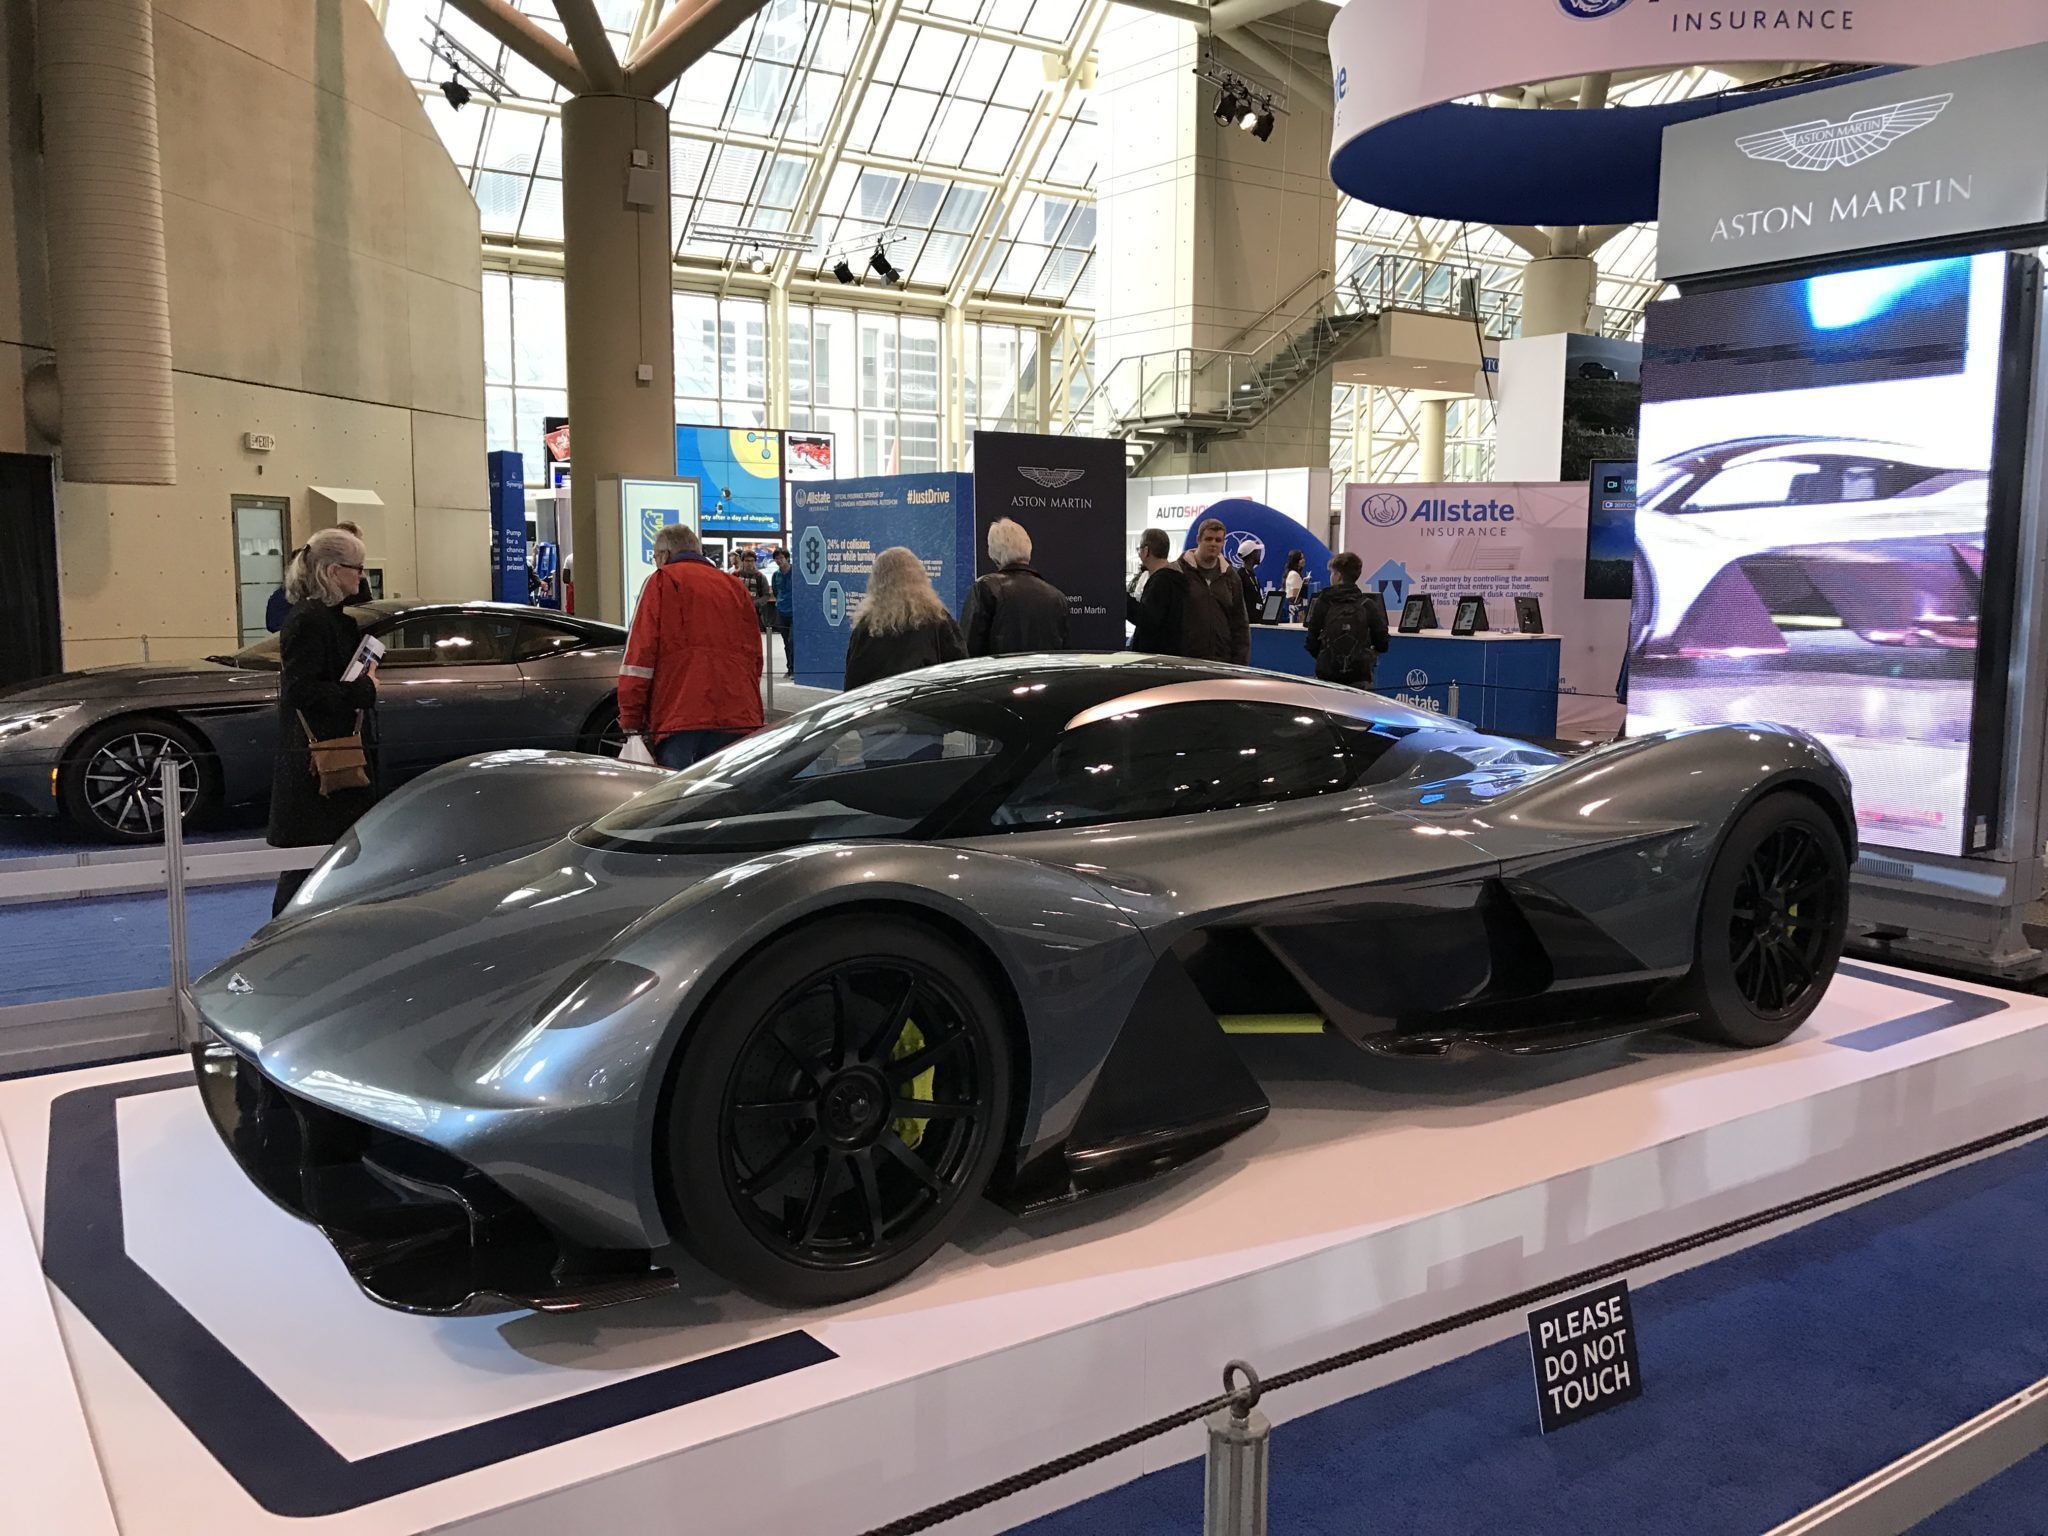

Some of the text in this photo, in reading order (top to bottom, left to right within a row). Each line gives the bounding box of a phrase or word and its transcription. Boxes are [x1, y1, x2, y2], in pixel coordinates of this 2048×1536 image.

[1672, 10, 1854, 32] INSURANCE
[1796, 117, 1881, 146] ASTON MARTIN
[1709, 174, 1973, 243] ASTON MARTIN
[806, 491, 831, 504] Allstate
[907, 488, 950, 505] #JustDrive
[1011, 496, 1092, 509] ASTON MARTIN
[1156, 505, 1209, 519] AUTOSHO
[1409, 499, 1515, 522] Allstate
[506, 529, 522, 537] Pump
[1420, 527, 1507, 537] INSURANCE
[827, 538, 871, 550] 24% of collisions
[827, 553, 842, 561] occur
[842, 551, 857, 561] while
[827, 563, 873, 573] or at intersections
[1421, 575, 1438, 583] Save
[1439, 576, 1461, 584] money
[1463, 575, 1471, 584] by
[1473, 575, 1510, 583] controlling
[1069, 605, 1107, 615] ton Martin
[1539, 1296, 1624, 1349] PLEASE
[1544, 1328, 1627, 1383] DO NOT
[1548, 1360, 1631, 1415] TOUCH
